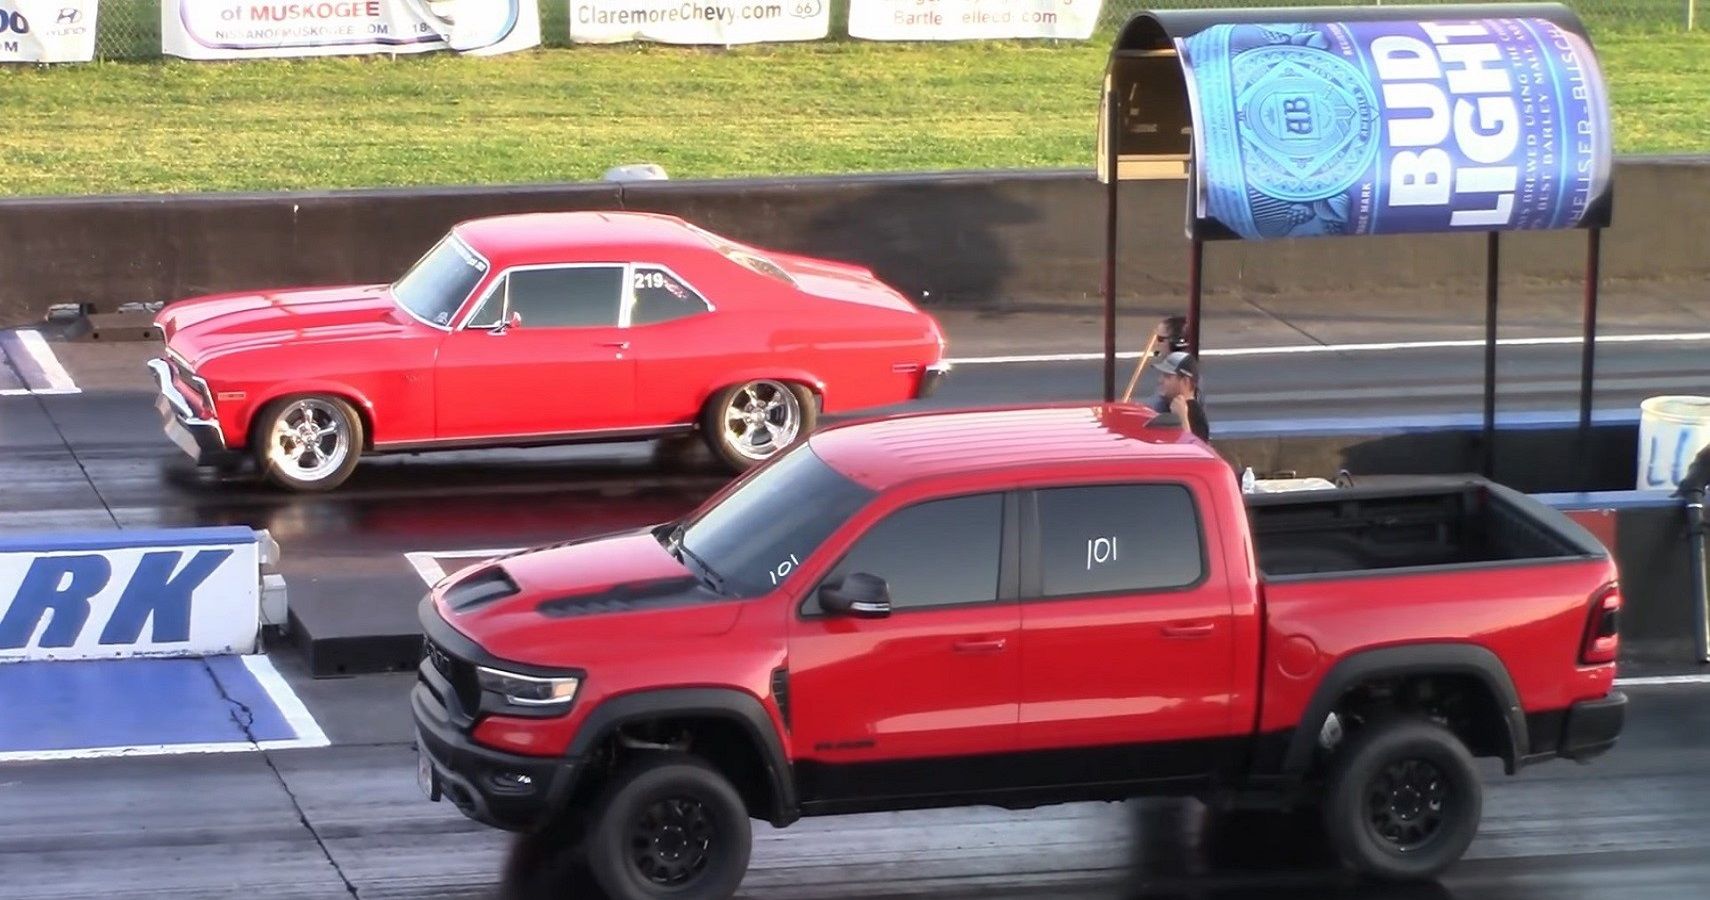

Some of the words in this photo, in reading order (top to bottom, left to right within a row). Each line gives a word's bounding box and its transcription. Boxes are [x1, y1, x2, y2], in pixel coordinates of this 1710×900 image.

[221, 5, 242, 21] of
[250, 1, 380, 21] MUSKOGEE
[577, 2, 782, 25] ClaremoreChevy.com
[797, 3, 812, 14] 66
[1519, 74, 1535, 126] USING
[1370, 35, 1452, 207] BUD
[1418, 20, 1520, 227] LIGHT
[1539, 94, 1554, 165] BARLEY
[1522, 134, 1537, 203] BREWED
[1360, 183, 1371, 213] MARK
[634, 273, 663, 289] 219
[769, 553, 799, 585] 101
[1087, 536, 1117, 570] 101
